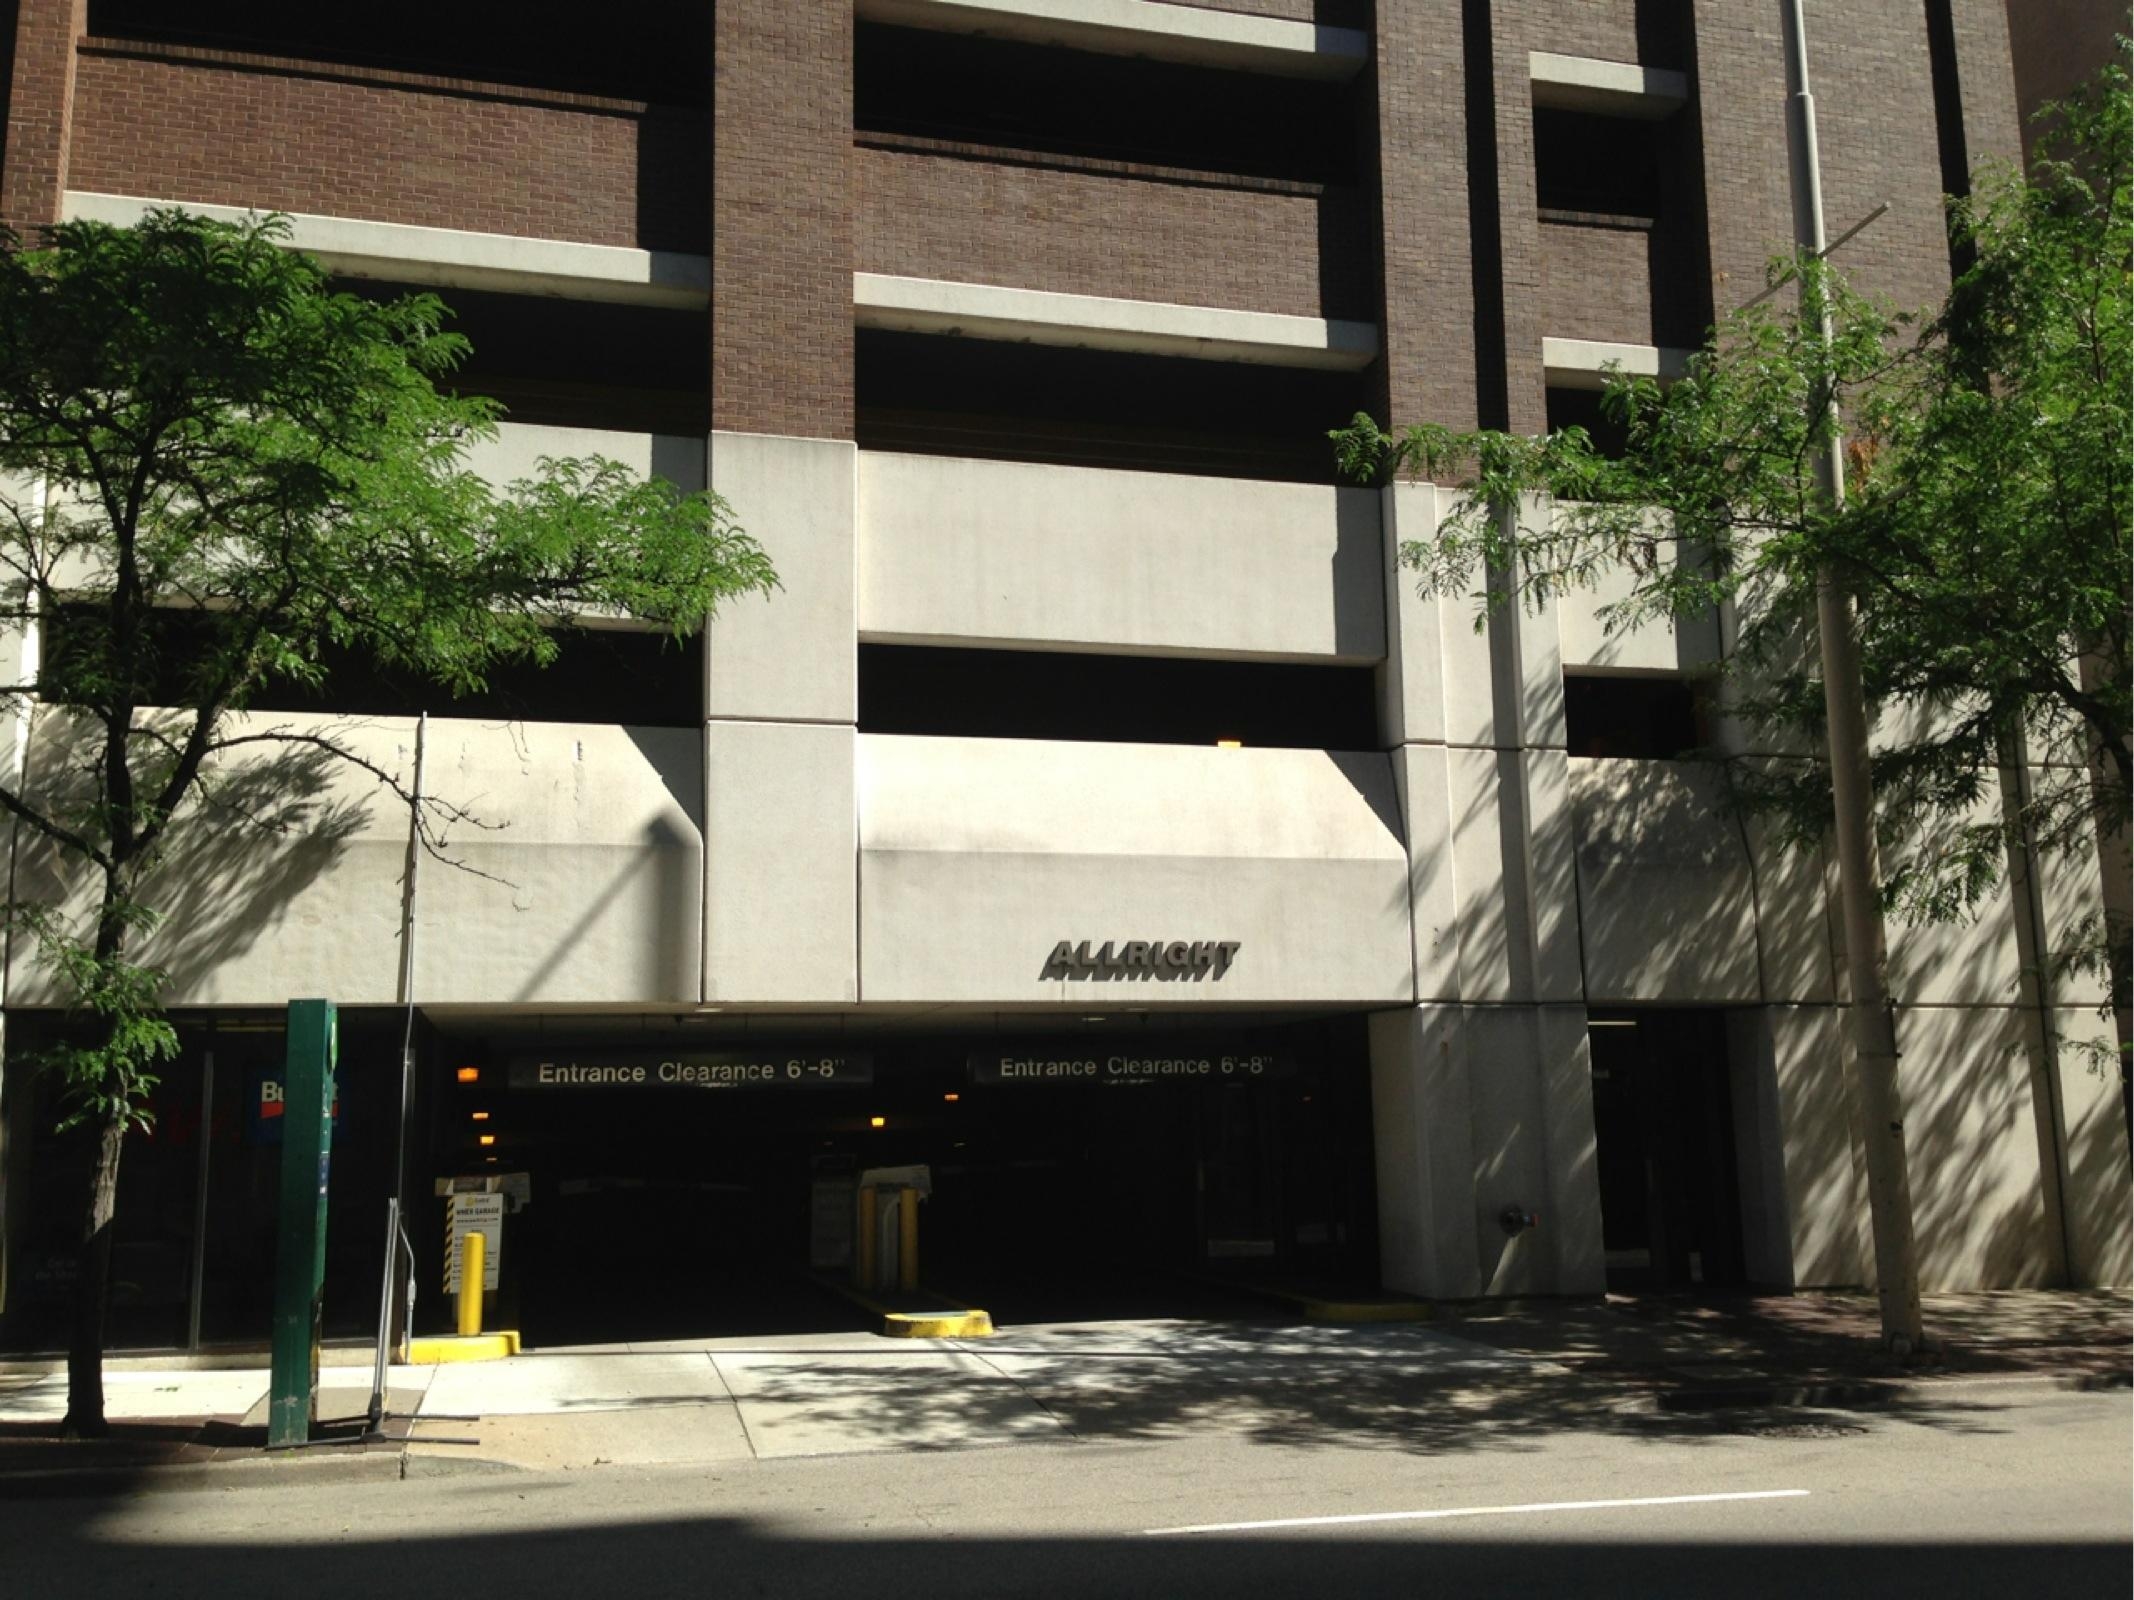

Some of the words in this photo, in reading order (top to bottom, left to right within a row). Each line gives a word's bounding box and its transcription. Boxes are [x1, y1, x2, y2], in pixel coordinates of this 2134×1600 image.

[1048, 941, 1242, 968] ALLRIGHT
[538, 1063, 647, 1083] Entrance
[657, 1060, 776, 1082] Clearance
[999, 1057, 1098, 1077] Entrance
[1107, 1056, 1211, 1075] Clearance
